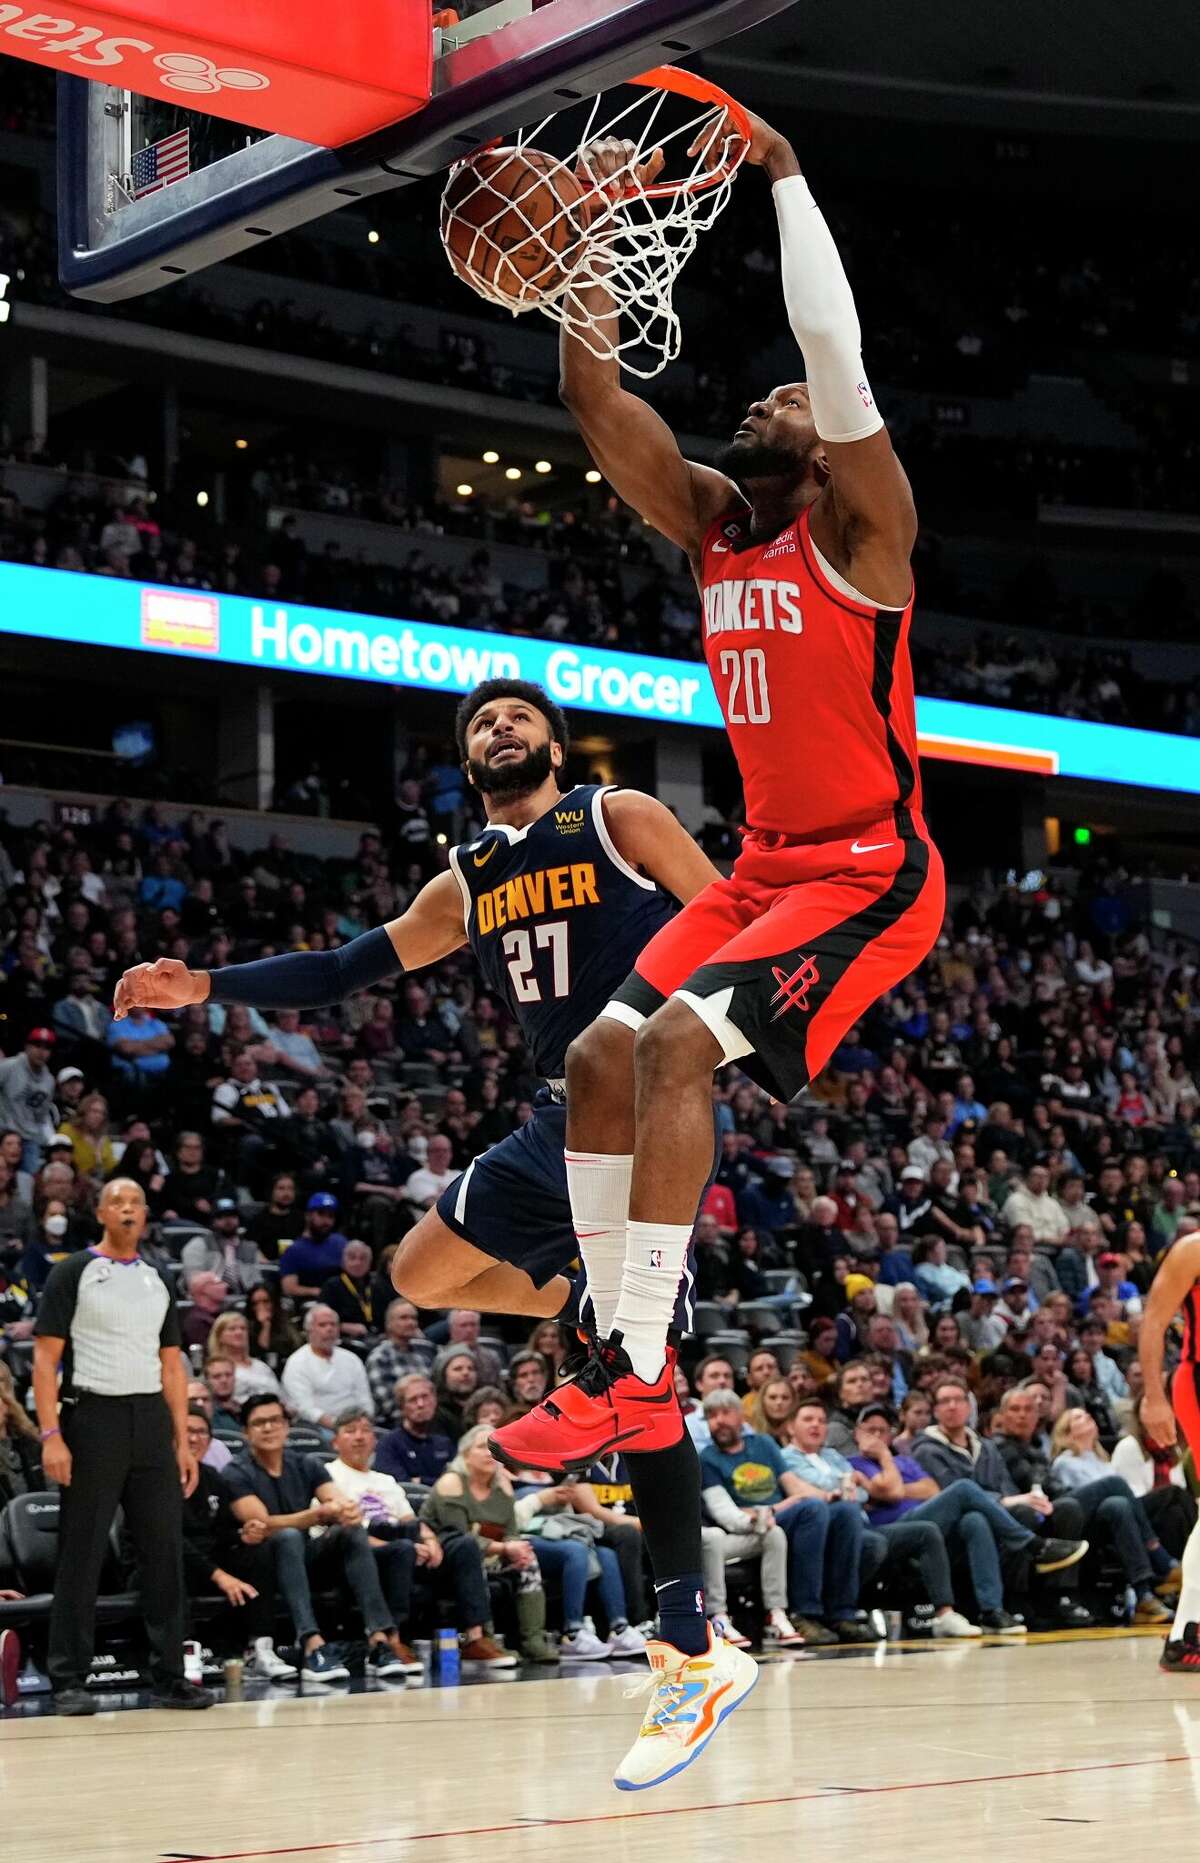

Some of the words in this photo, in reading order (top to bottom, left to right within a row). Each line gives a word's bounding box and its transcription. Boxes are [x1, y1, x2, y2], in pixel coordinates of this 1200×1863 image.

[769, 531, 795, 549] redit
[546, 648, 700, 717] Grocer
[719, 648, 773, 724] 20
[554, 808, 584, 824] WU
[555, 822, 585, 831] Western
[560, 827, 581, 835] Union
[476, 862, 601, 936] DENVER
[501, 921, 570, 1003] 27
